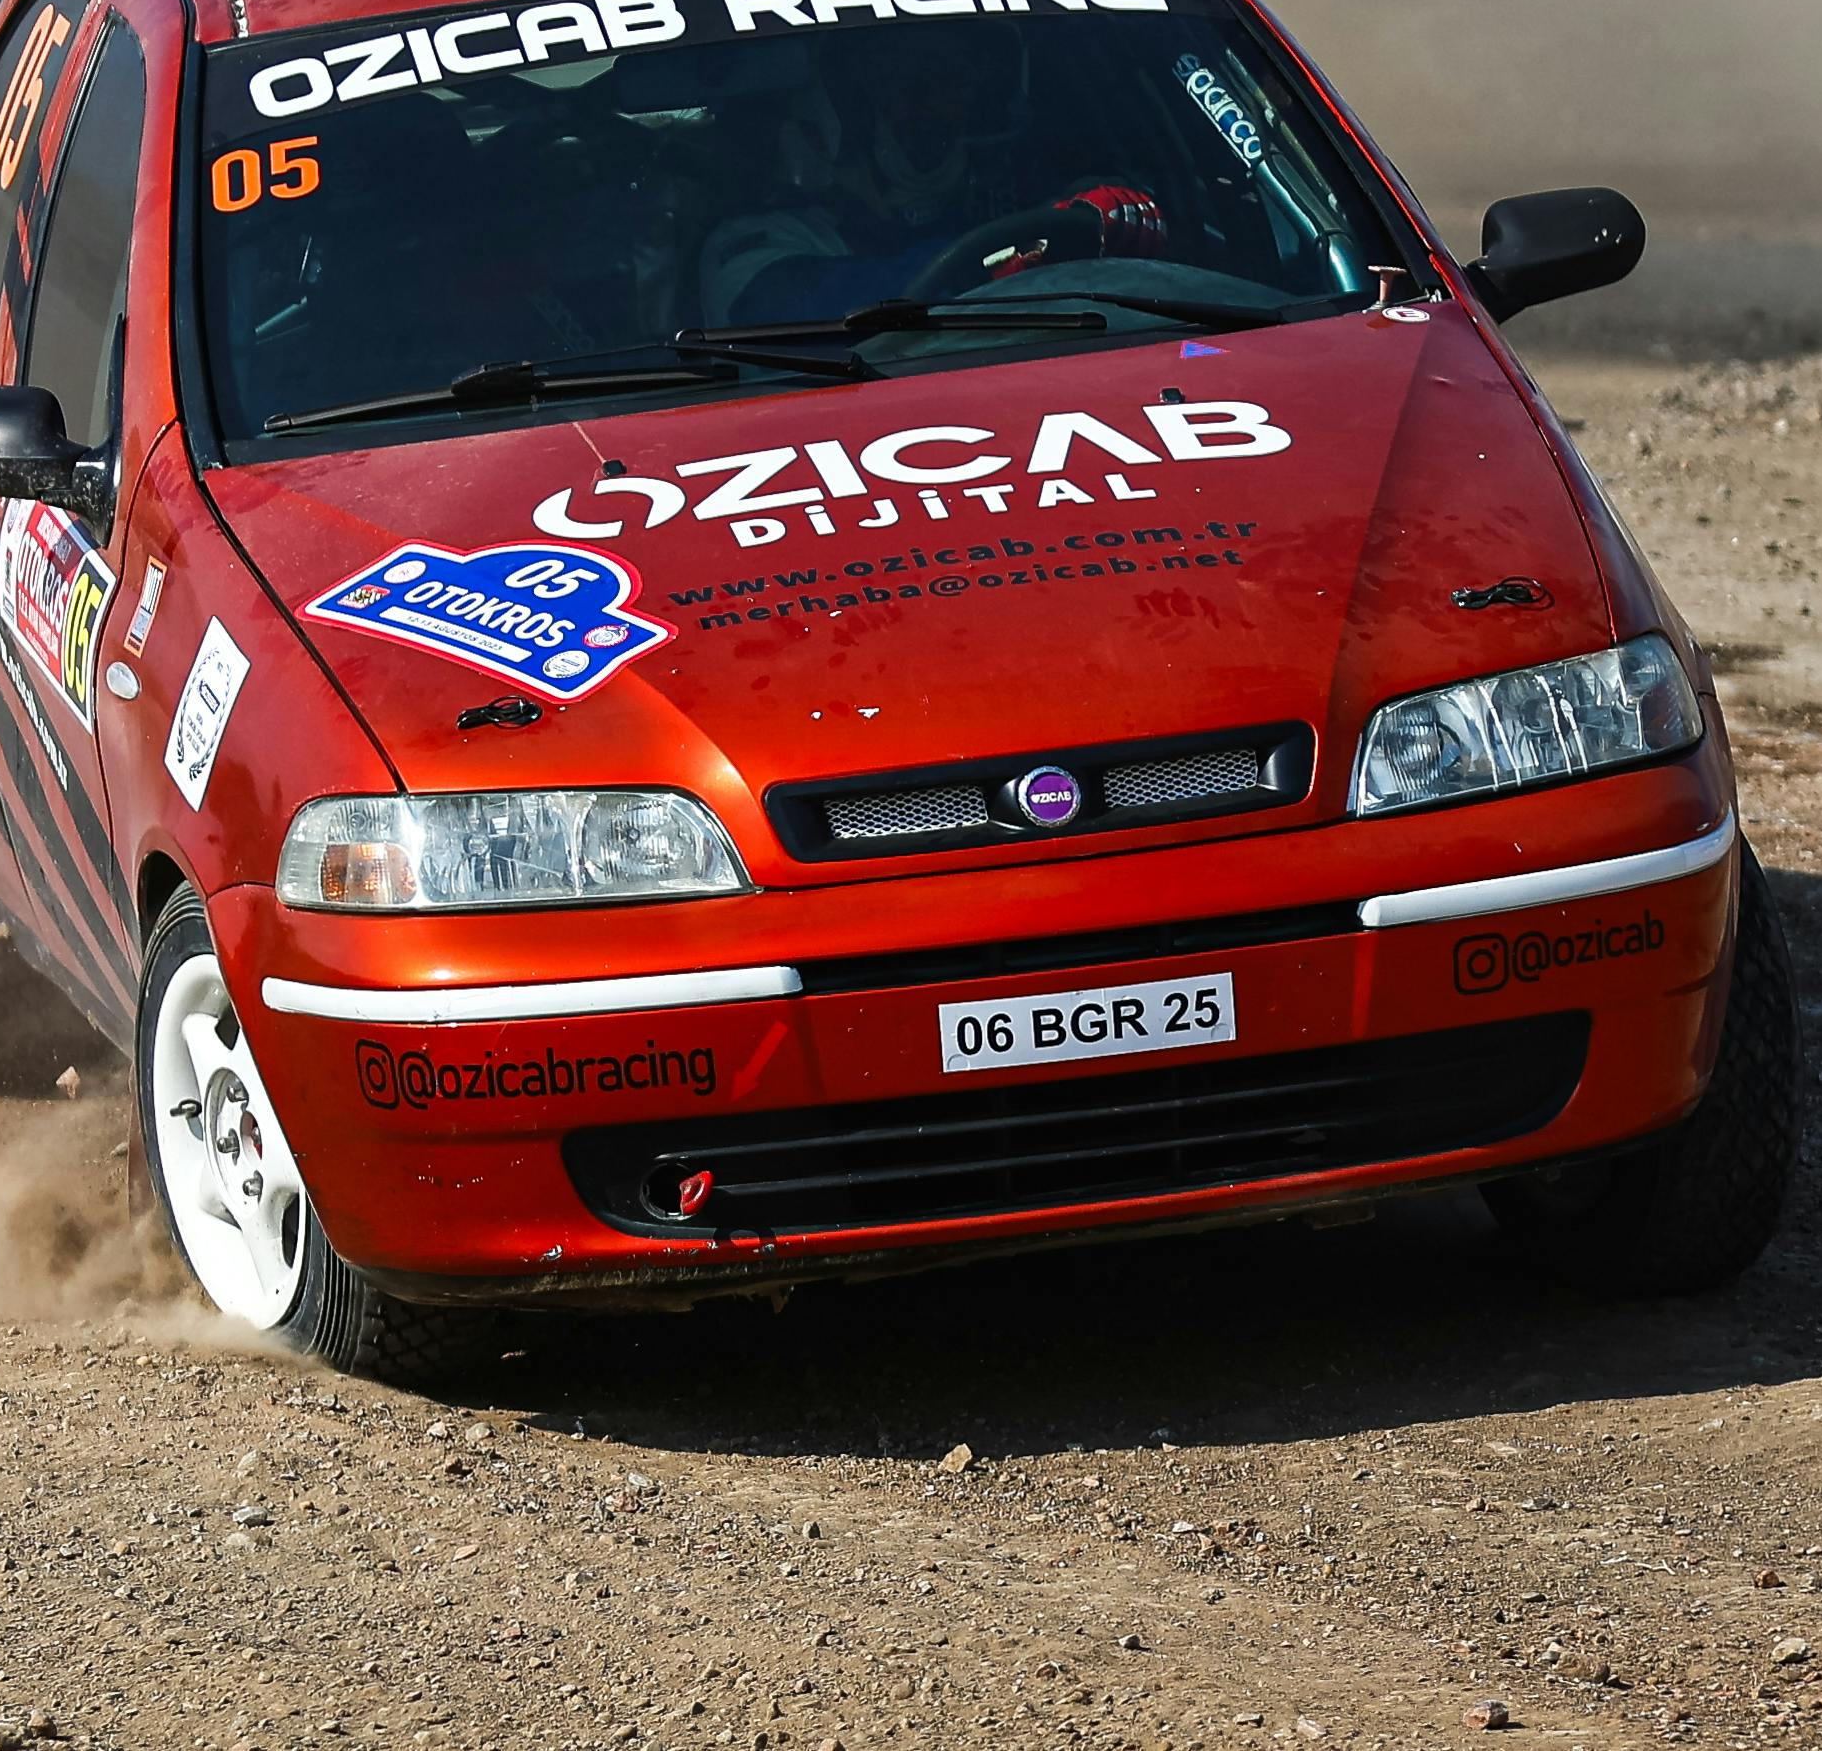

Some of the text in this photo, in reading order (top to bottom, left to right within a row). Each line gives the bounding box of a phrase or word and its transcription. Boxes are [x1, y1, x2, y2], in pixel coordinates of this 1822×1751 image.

[211, 137, 320, 212] 05
[532, 401, 1293, 539] OZICAB
[505, 559, 599, 599] 05
[668, 520, 1258, 608] www.ozicab.com.tr
[699, 548, 1244, 631] merhaba@ozicab.net
[64, 572, 103, 703] 05
[403, 581, 575, 647] OTOKROS
[1512, 909, 1665, 982] @ozicab
[956, 988, 1221, 1055] 06 BGR 25
[398, 1040, 716, 1109] @ozicabracing
